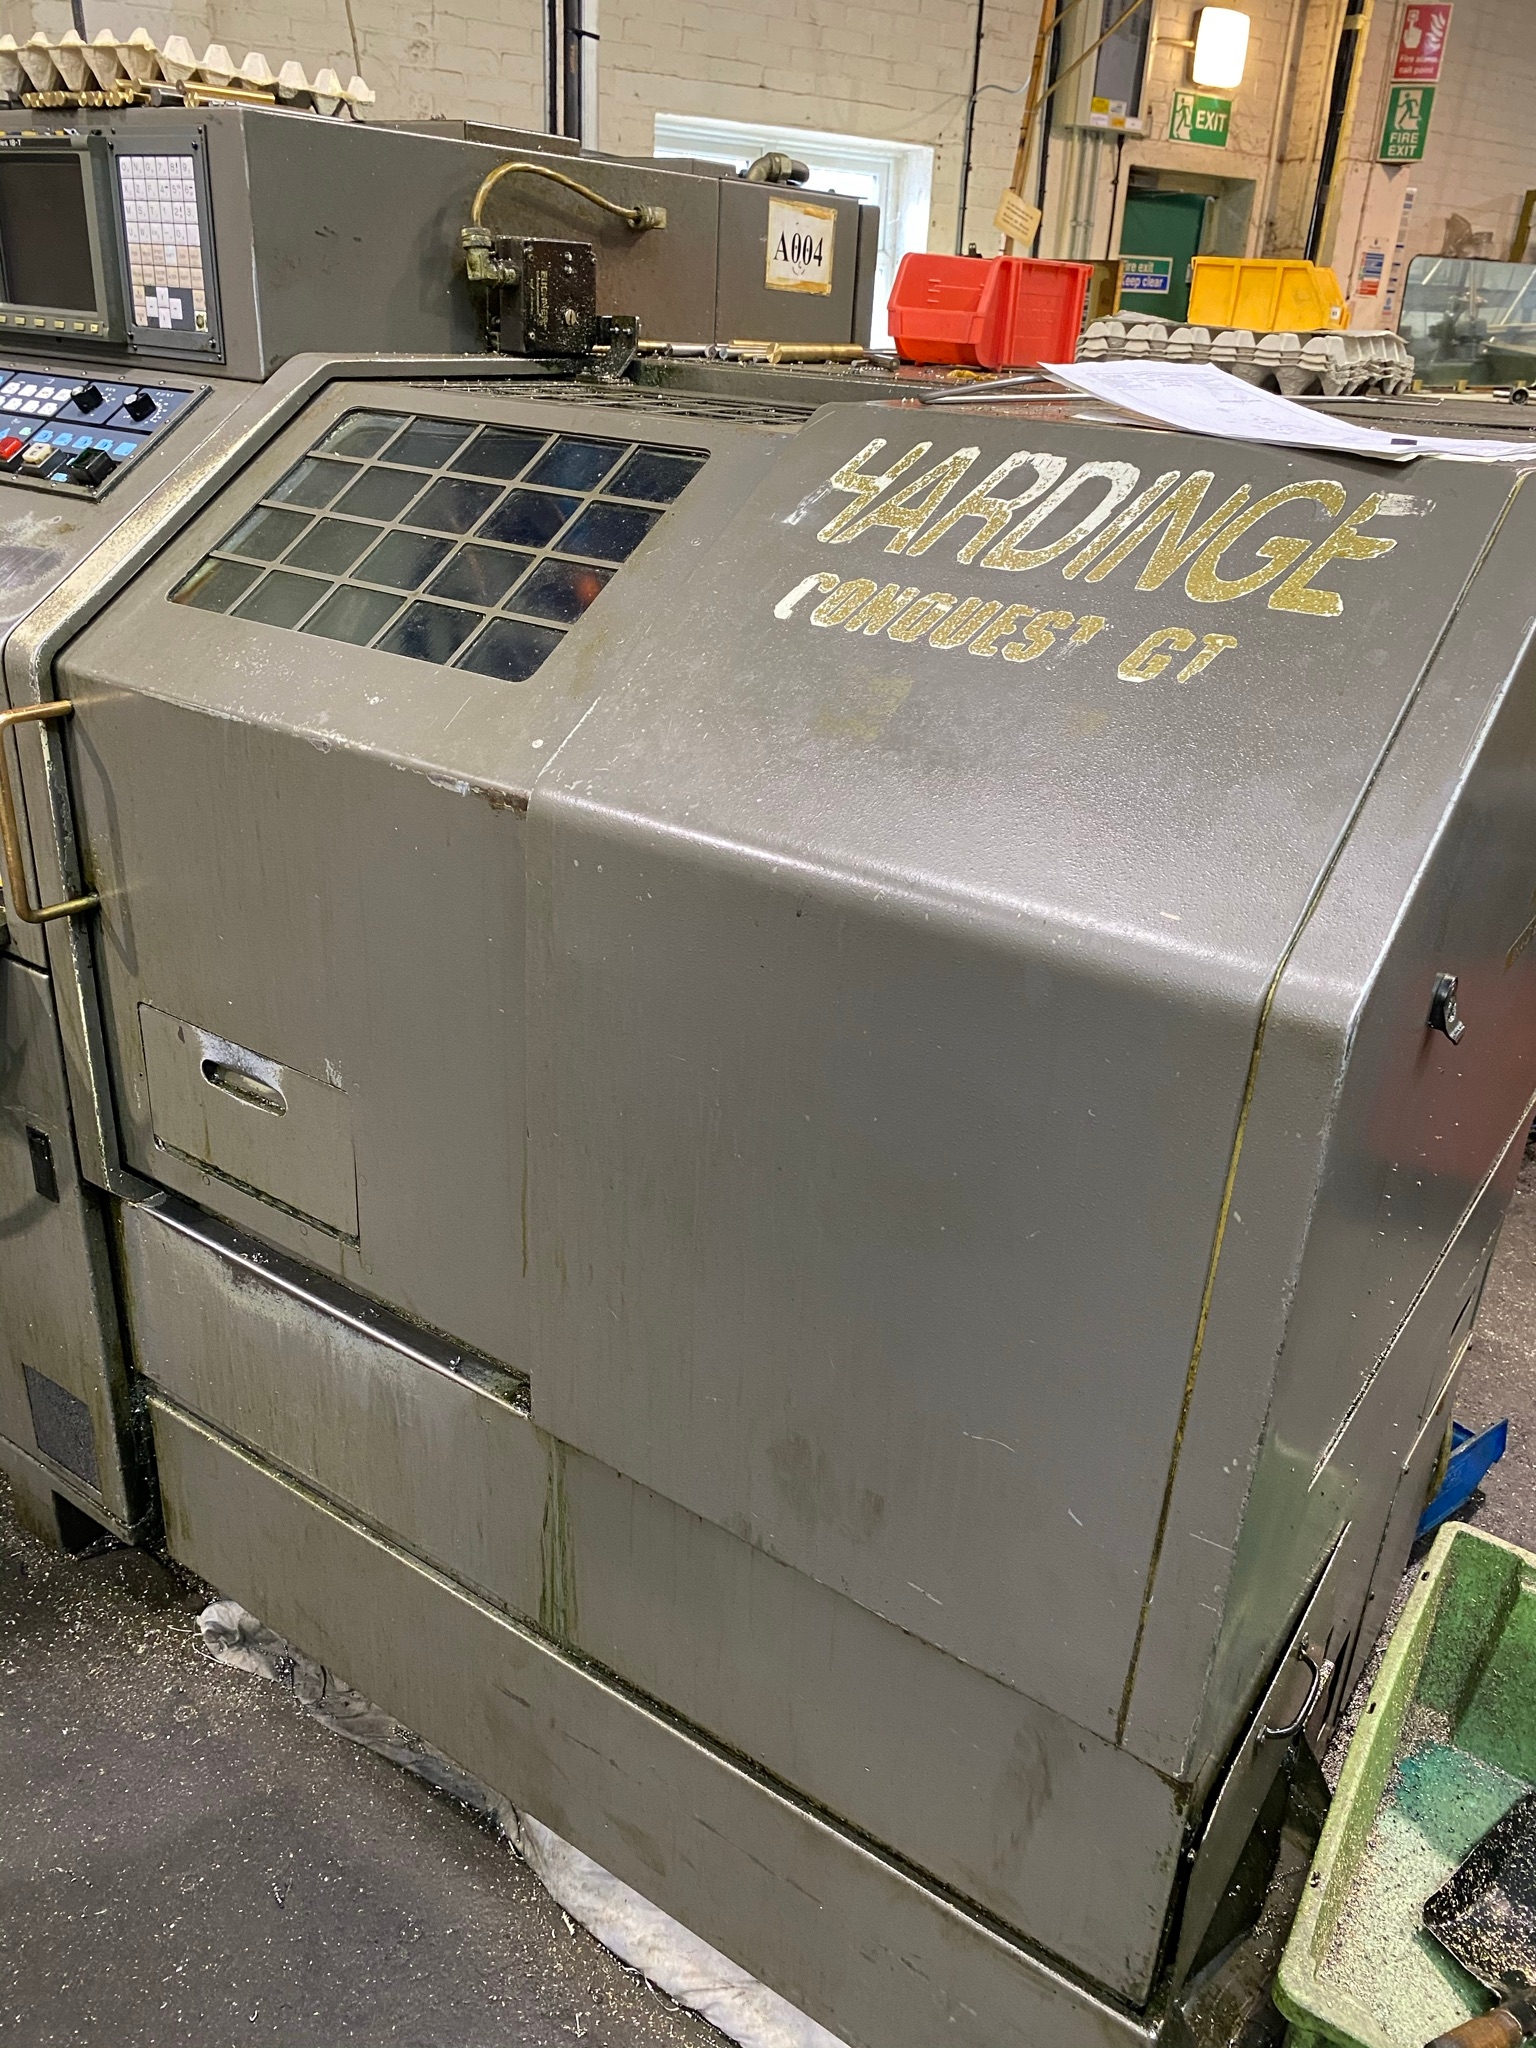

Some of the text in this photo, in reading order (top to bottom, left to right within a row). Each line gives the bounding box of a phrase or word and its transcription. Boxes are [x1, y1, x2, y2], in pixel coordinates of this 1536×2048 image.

[1399, 54, 1415, 63] Fire
[1398, 65, 1434, 76] call point
[1195, 110, 1227, 132] EXIT
[1389, 132, 1420, 144] FIRE
[1387, 144, 1417, 157] EXIT
[773, 230, 824, 268] A004
[1123, 259, 1155, 273] ire exit
[1142, 276, 1163, 288] clear
[812, 438, 1434, 617] HARDINGE
[1117, 626, 1238, 683] GT
